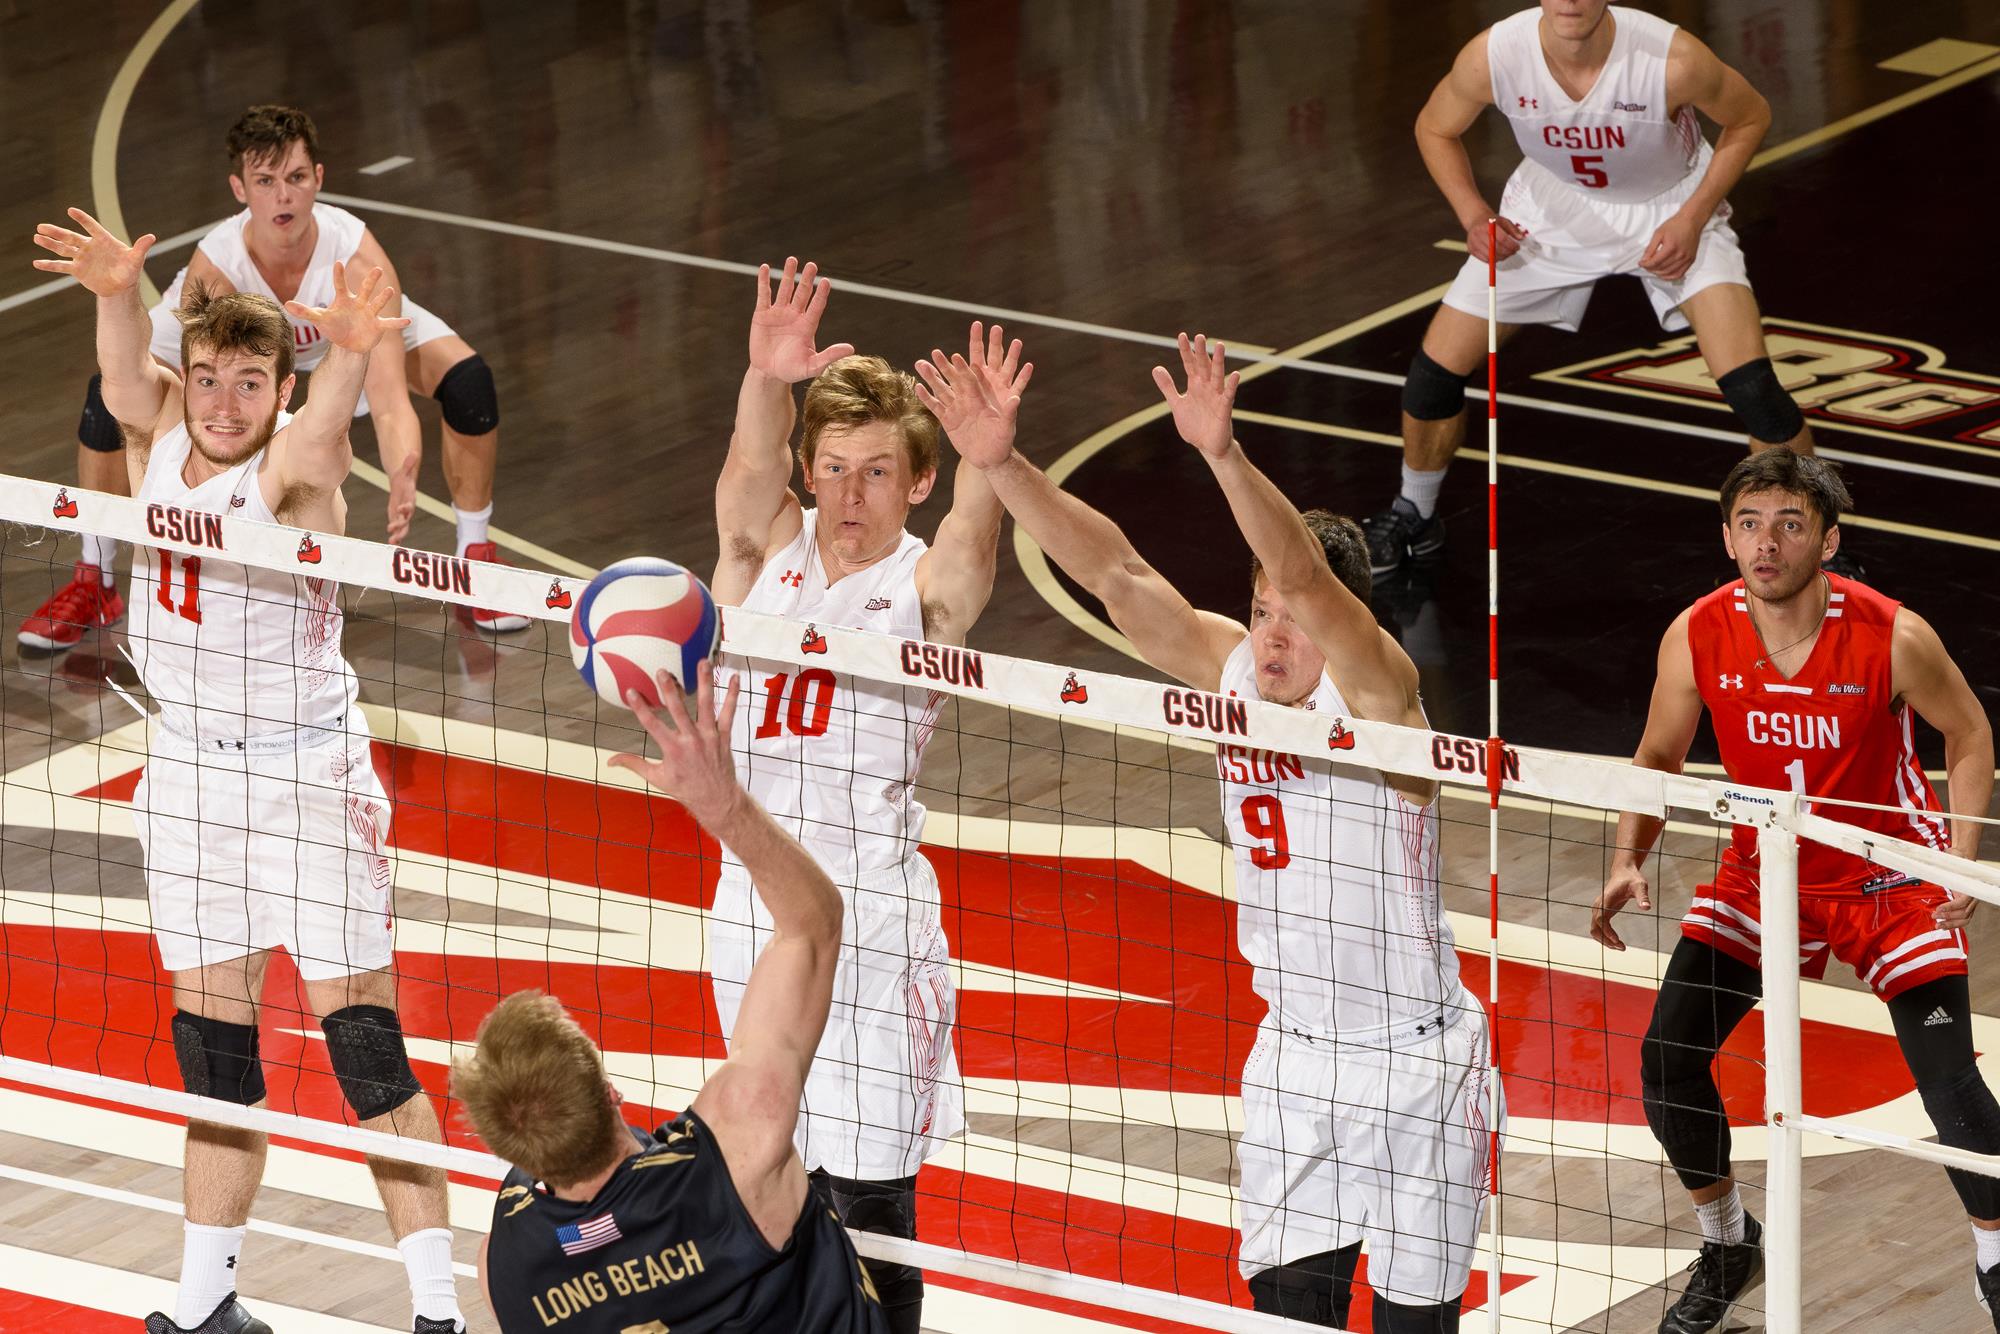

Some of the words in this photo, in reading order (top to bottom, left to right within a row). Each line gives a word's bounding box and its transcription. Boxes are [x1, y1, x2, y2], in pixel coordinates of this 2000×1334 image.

[1543, 125, 1625, 149] CSUN
[1571, 155, 1609, 189] 5
[147, 503, 224, 551] CSUN
[157, 548, 202, 625] 11
[393, 548, 472, 596] CSUN
[901, 640, 984, 690] CSUN
[755, 668, 837, 740] 10
[1163, 688, 1248, 736] CSUN
[1746, 711, 1841, 749] CSUN
[1733, 793, 1774, 806] Senoh
[1784, 758, 1812, 814] 1
[1240, 794, 1291, 870] 9
[1924, 1016, 1953, 1026] adidas
[532, 1270, 607, 1327] LONG
[607, 1240, 705, 1297] BEACH
